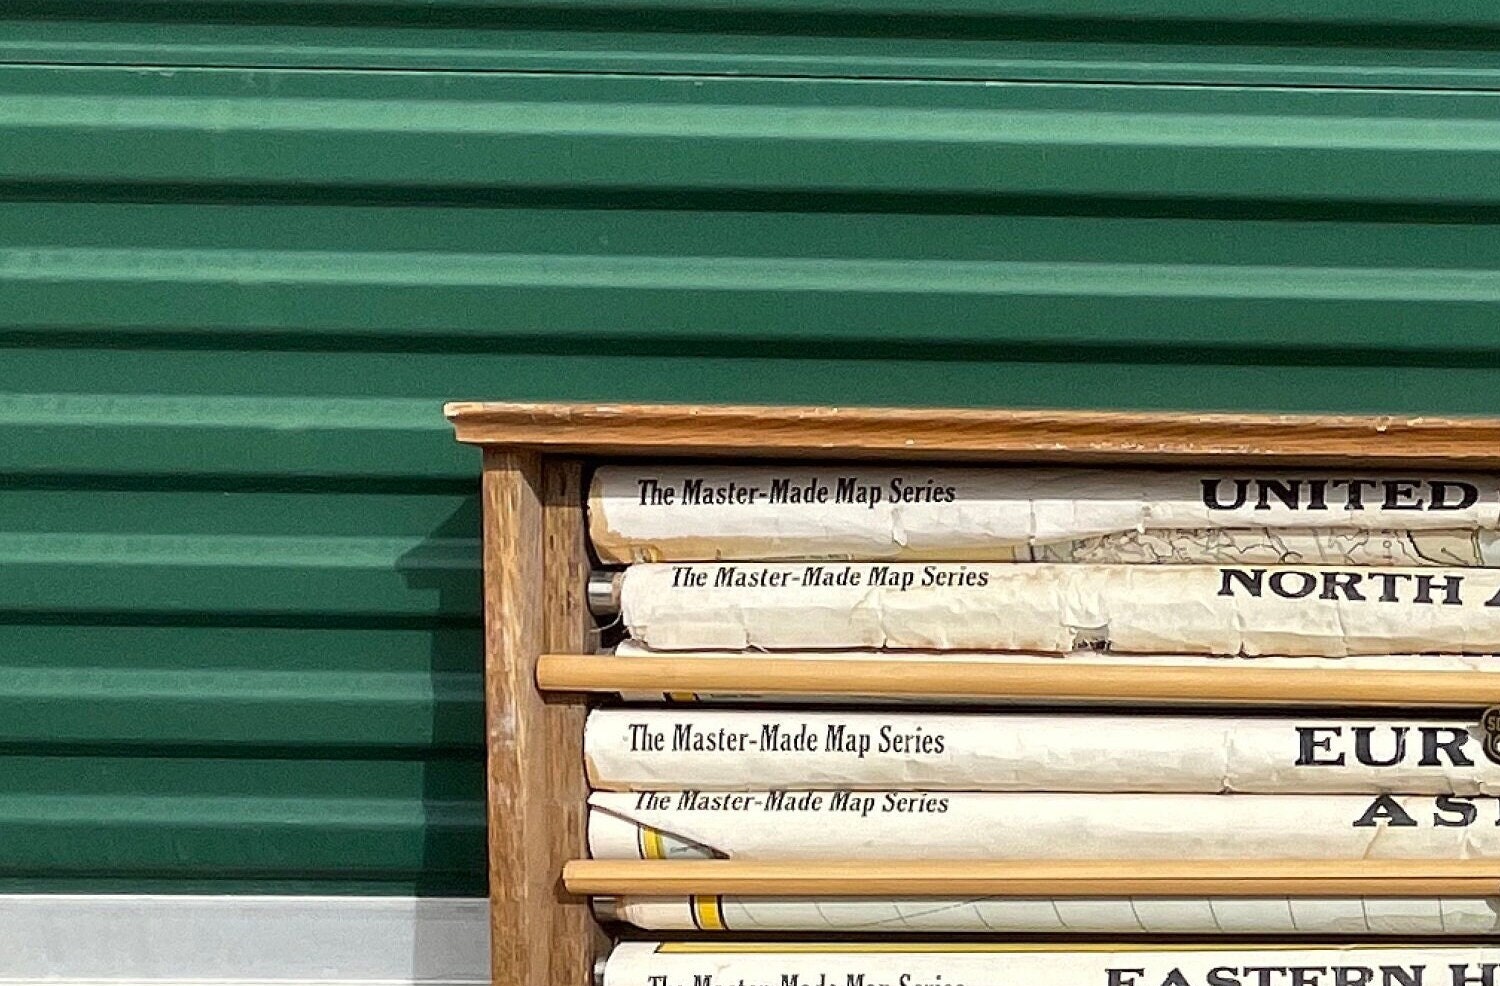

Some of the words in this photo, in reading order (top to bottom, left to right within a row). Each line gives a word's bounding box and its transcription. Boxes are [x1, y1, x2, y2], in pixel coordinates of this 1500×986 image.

[637, 478, 676, 506] The
[681, 477, 828, 507] Master-Made
[834, 477, 883, 510] Map
[888, 478, 957, 505] Series
[1200, 478, 1480, 512] UNITED
[671, 565, 709, 588] The
[714, 565, 862, 589] Master-Made
[867, 566, 915, 592] Map
[921, 566, 990, 588] Series
[1217, 568, 1465, 607] NORTH
[628, 723, 665, 752] The
[671, 723, 818, 753] Master-Made
[824, 724, 871, 759] Map
[878, 724, 945, 755] Series
[634, 791, 672, 811] The
[676, 791, 823, 812] Master-Made
[828, 791, 875, 818] Map
[881, 792, 950, 814] Series
